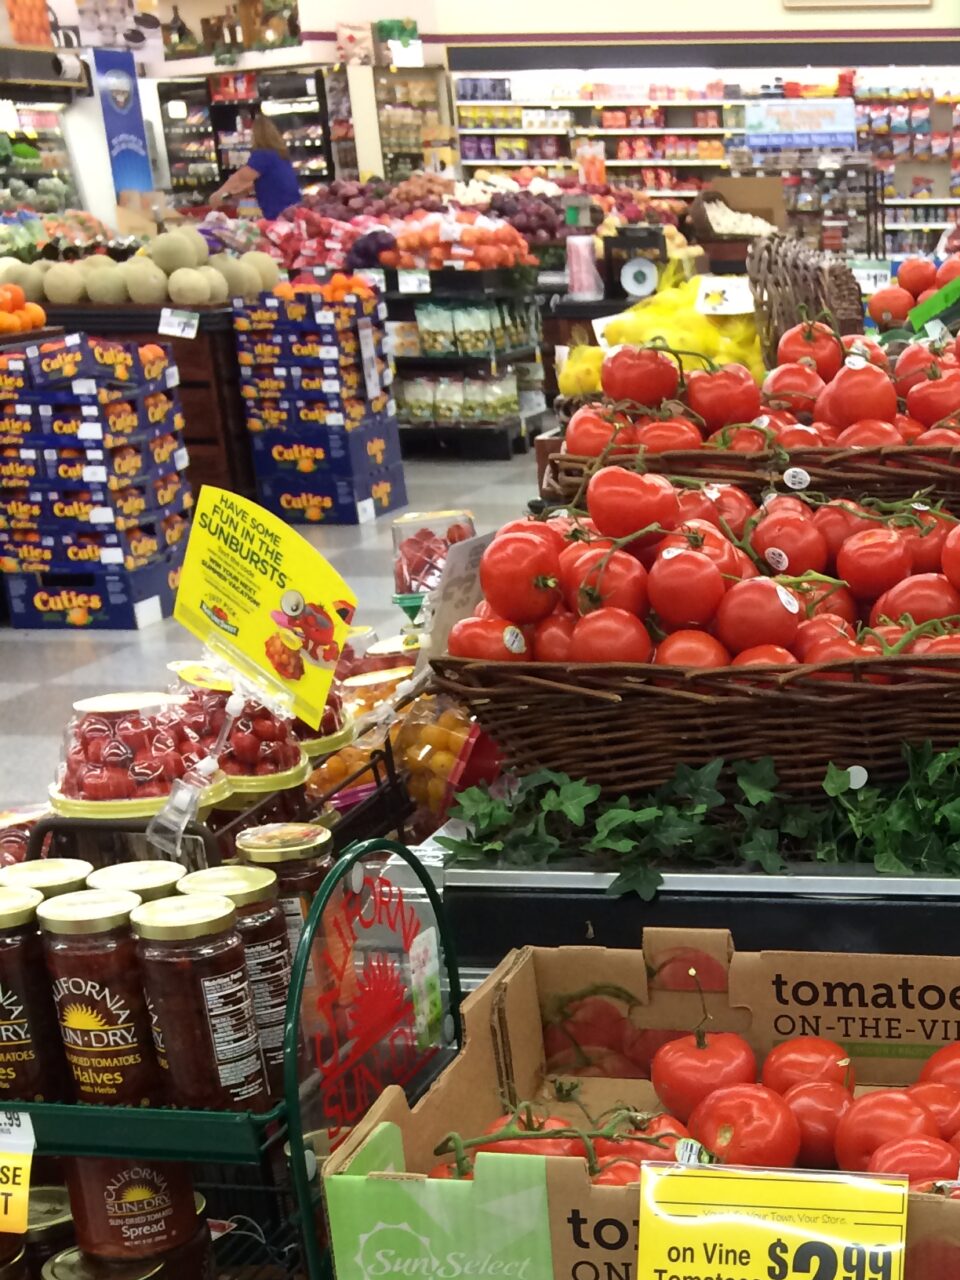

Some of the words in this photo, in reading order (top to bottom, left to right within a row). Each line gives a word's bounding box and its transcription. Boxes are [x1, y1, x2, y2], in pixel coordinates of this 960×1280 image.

[271, 443, 326, 461] Cuties
[279, 492, 334, 509] Cuties
[219, 494, 248, 524] HAVE
[250, 518, 282, 547] SOME
[211, 504, 240, 535] FUN
[240, 526, 256, 546] IN
[258, 537, 283, 567] THE
[198, 511, 289, 590] SUNBURSTS
[33, 590, 102, 612] Cuties
[91, 1053, 142, 1068] TOMATOES
[72, 1065, 124, 1085] Halves
[121, 1219, 166, 1240] Spread
[667, 1245, 695, 1264] on
[703, 1242, 751, 1267] Vine
